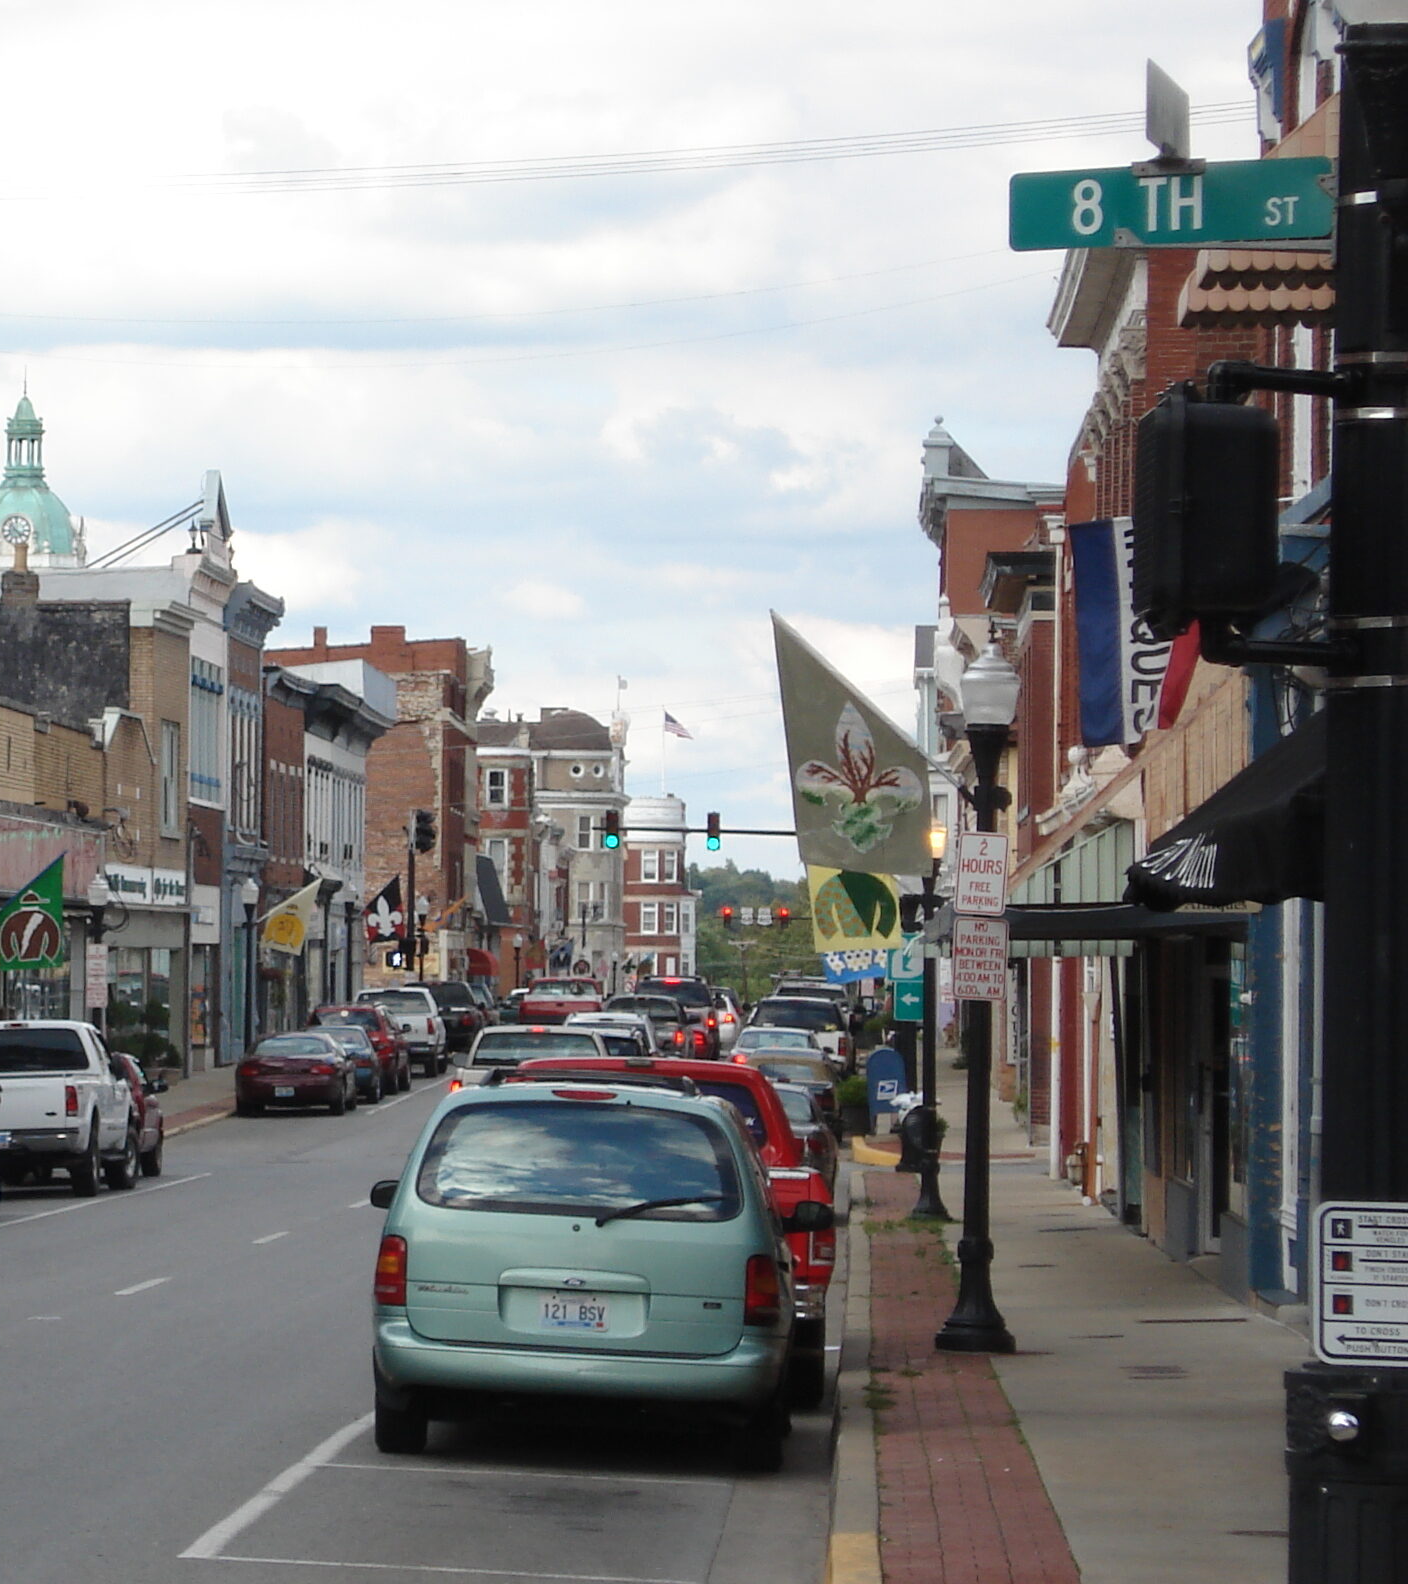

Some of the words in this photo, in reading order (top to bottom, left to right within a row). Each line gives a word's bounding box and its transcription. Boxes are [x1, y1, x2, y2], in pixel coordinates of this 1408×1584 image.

[1072, 179, 1104, 235] 8
[1138, 175, 1203, 233] TH
[1265, 196, 1300, 227] ST
[979, 841, 988, 856] 2
[961, 858, 1002, 875] HOURS
[969, 881, 991, 893] FREE
[961, 894, 999, 907] PARKING
[975, 922, 988, 932] NO
[960, 935, 1000, 946] PARKING
[959, 959, 1001, 970] BETWEEN
[977, 973, 990, 982] AM
[994, 974, 1004, 984] TO
[987, 986, 1000, 995] AM
[1358, 1215, 1382, 1224] START
[544, 1303, 567, 1320] 121
[579, 1305, 606, 1322] BSV
[1355, 1326, 1367, 1335] TO
[1370, 1327, 1401, 1337] CROSS
[1346, 1344, 1371, 1353] PUSH
